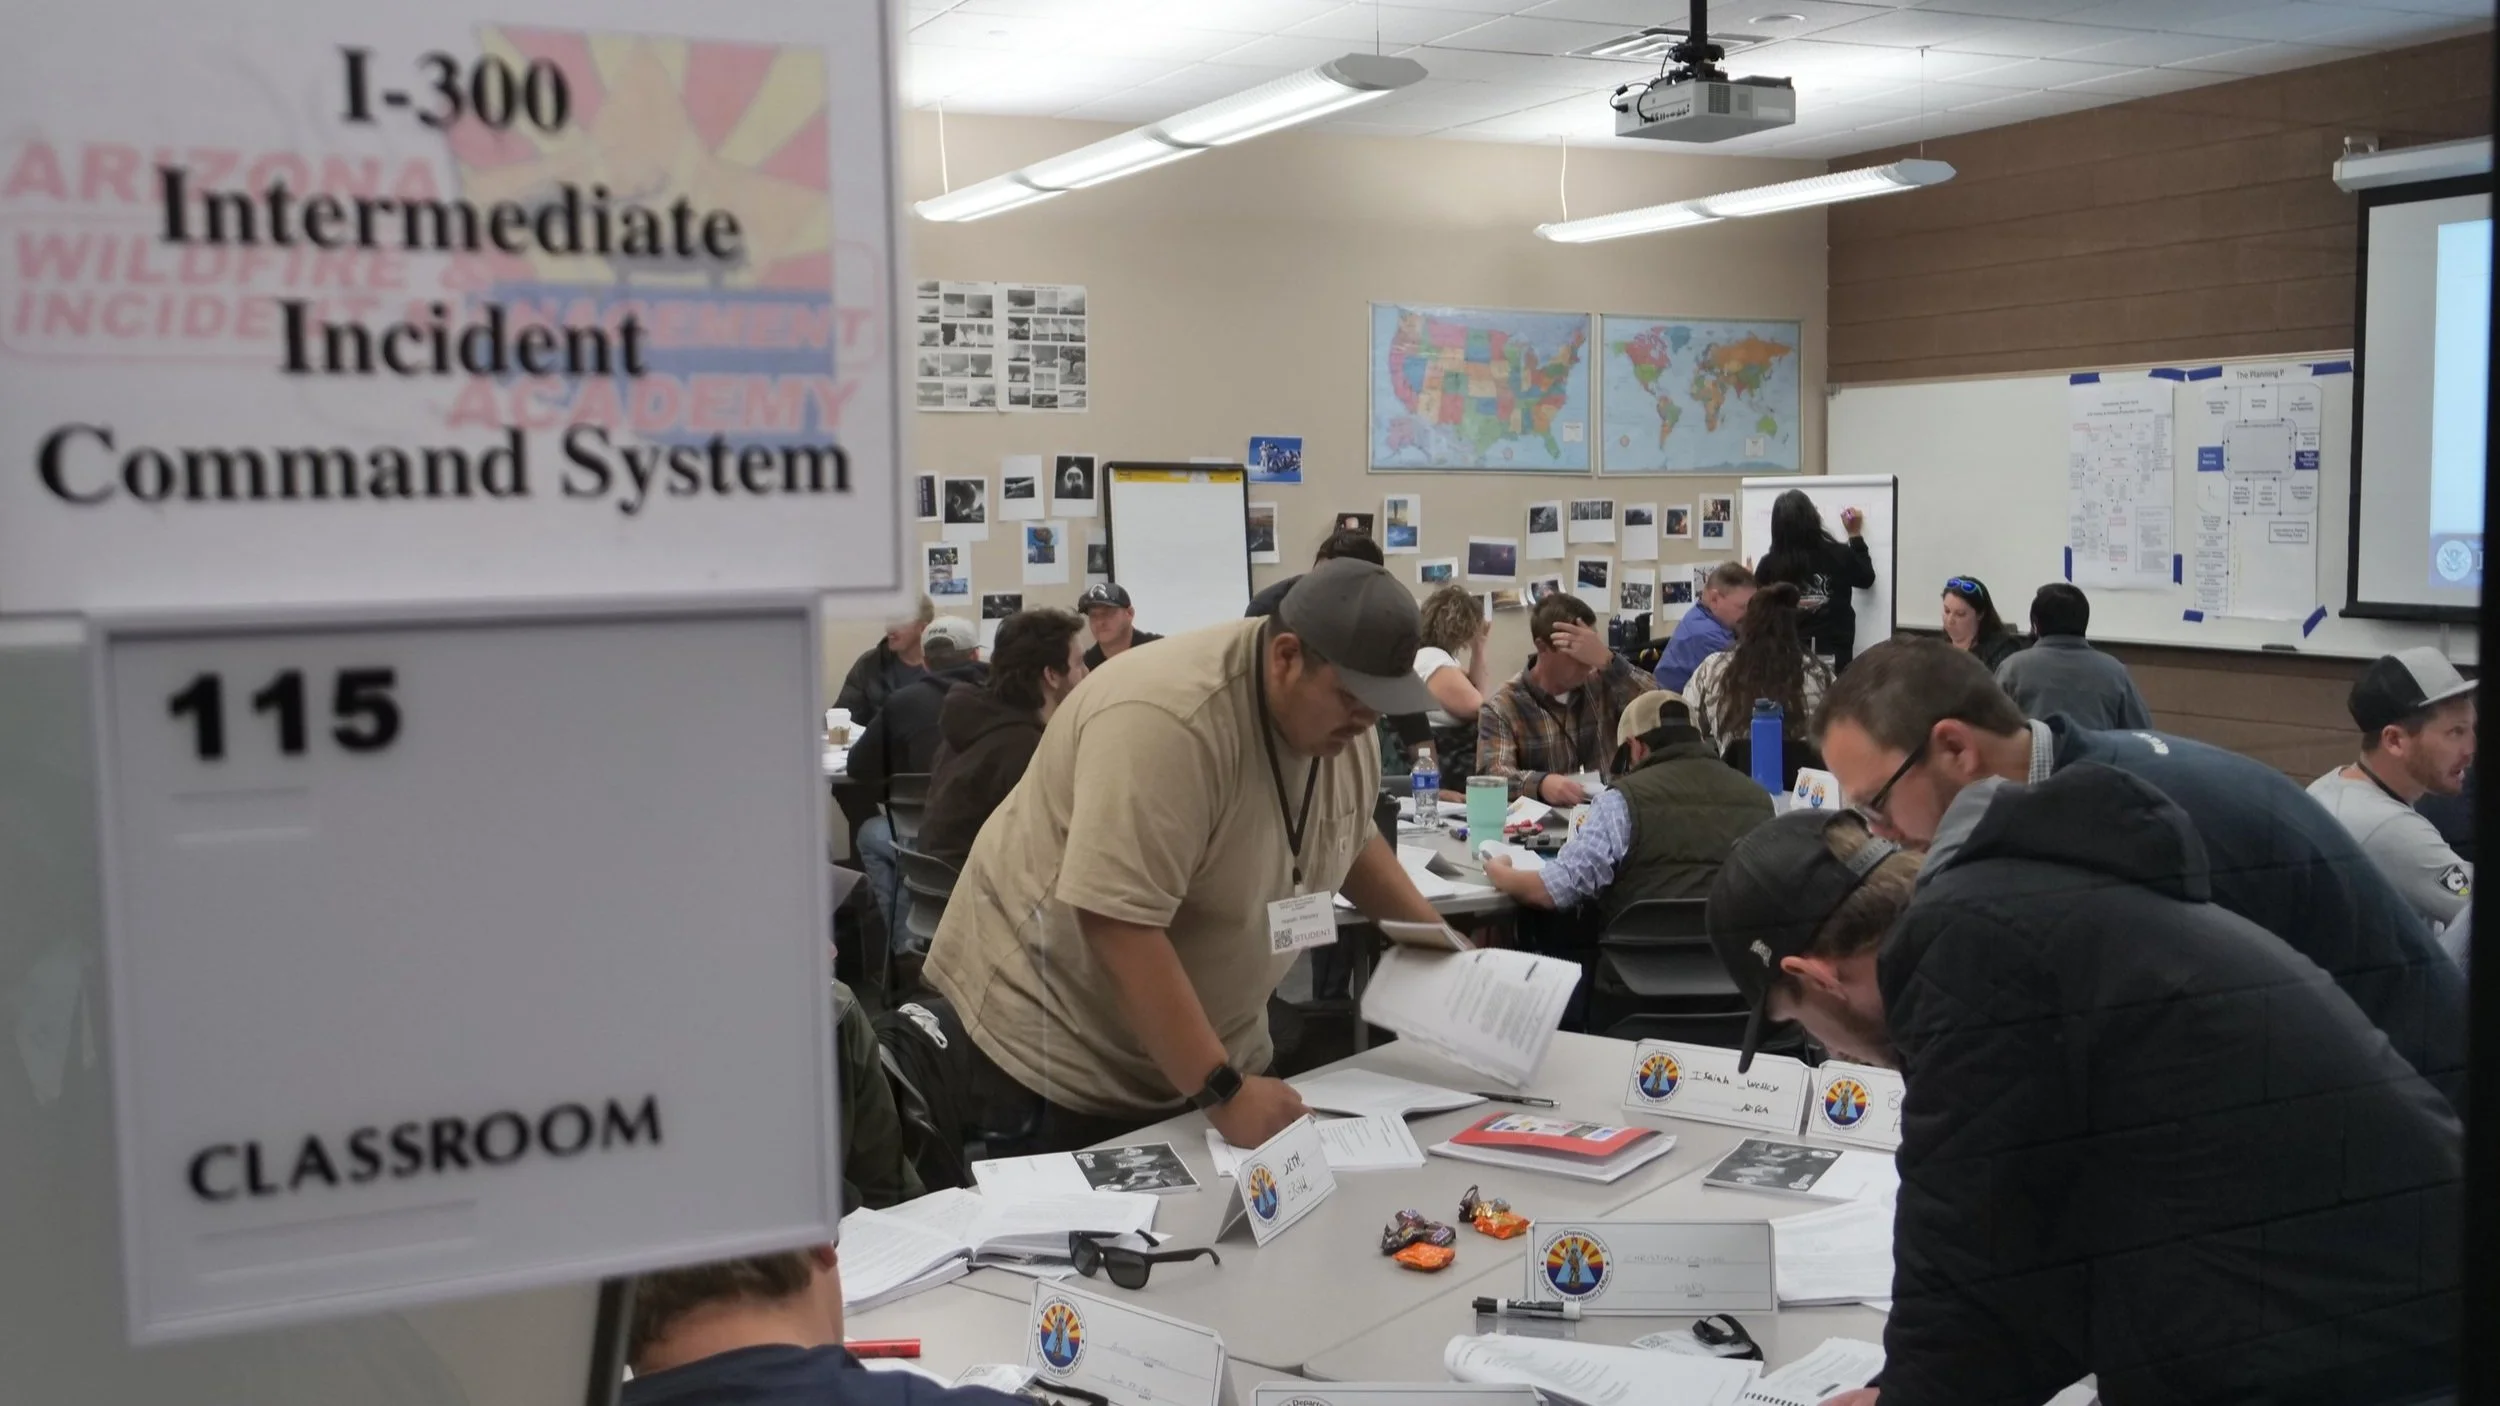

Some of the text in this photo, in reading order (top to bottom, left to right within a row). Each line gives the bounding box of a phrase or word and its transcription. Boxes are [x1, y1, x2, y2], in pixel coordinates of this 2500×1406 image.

[338, 45, 573, 132] I-300
[157, 165, 744, 261] Intermediate
[277, 298, 649, 379] Incident
[447, 372, 860, 433] ACADEMY
[37, 420, 853, 514] Command System
[167, 666, 404, 760] 115
[1294, 928, 1331, 942] STUDENT
[185, 1094, 663, 1204] CLASSROOM
[1543, 1234, 1563, 1254] Arizona
[1563, 1230, 1602, 1246] Department
[1540, 1270, 1563, 1300] Emergency
[1578, 1289, 1602, 1302] Military
[1599, 1270, 1611, 1290] Affairs
